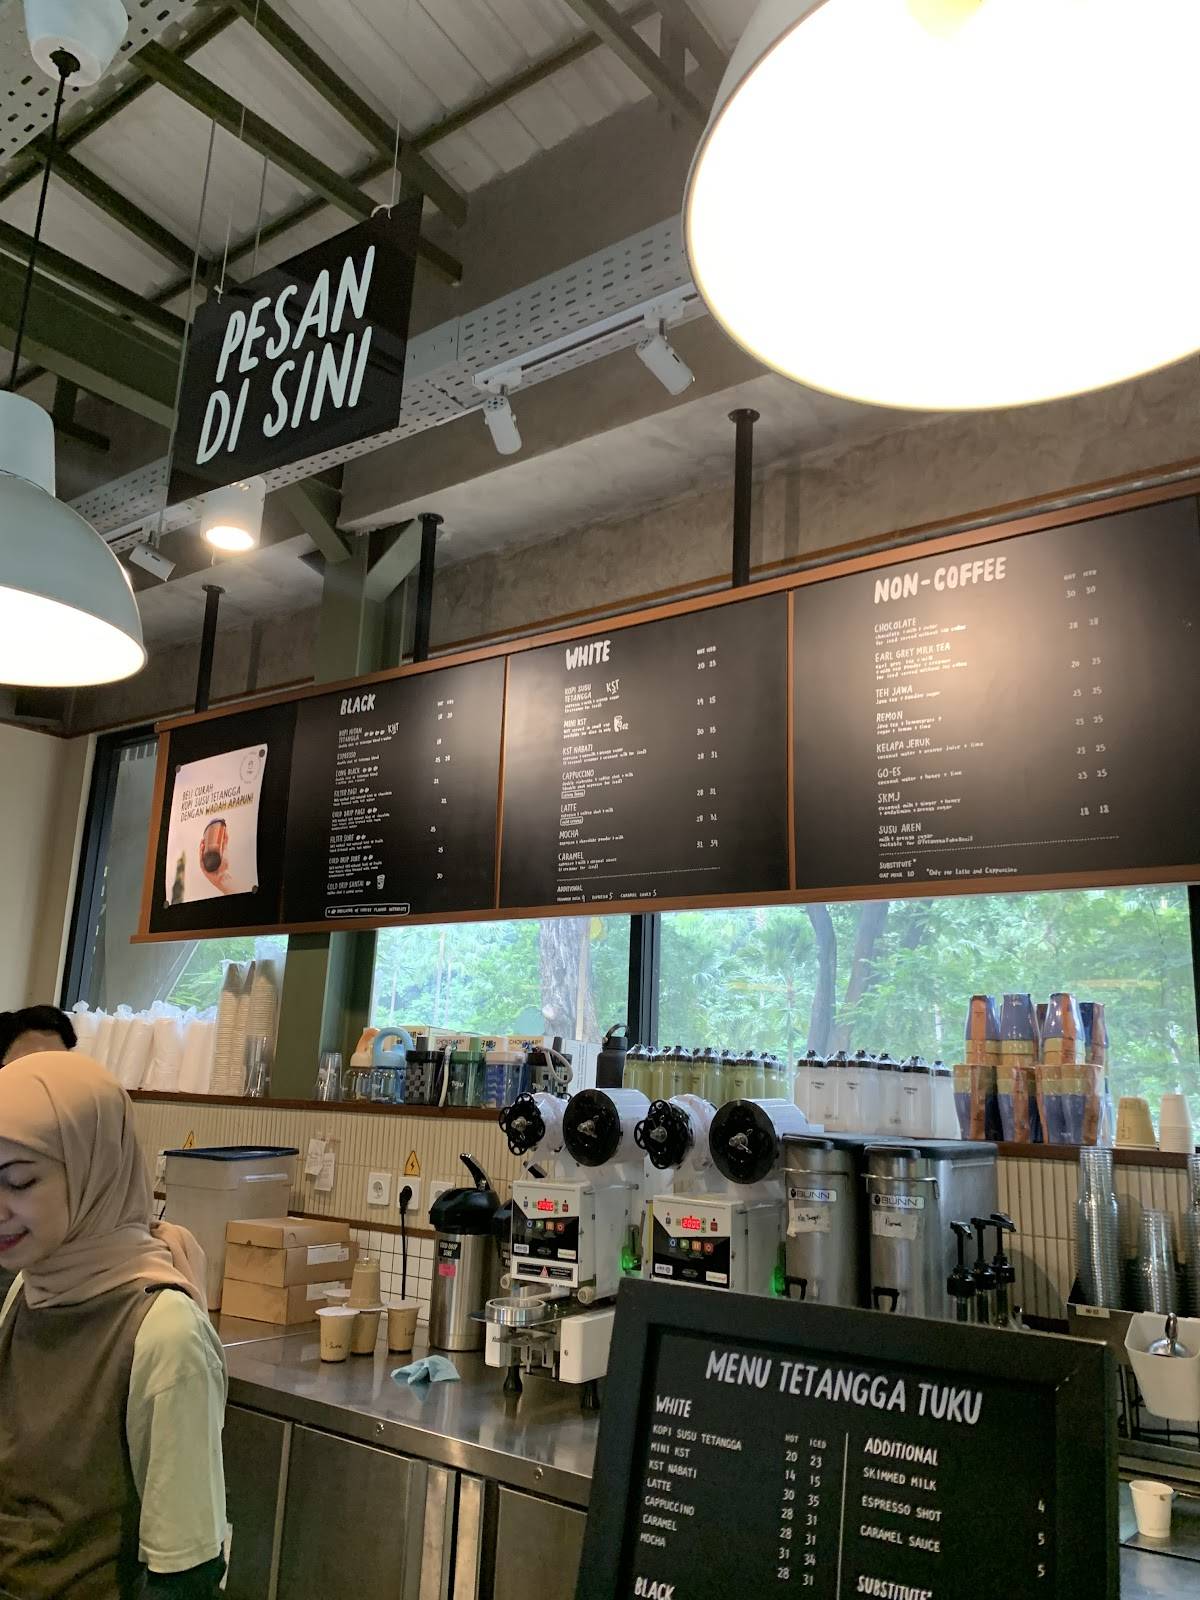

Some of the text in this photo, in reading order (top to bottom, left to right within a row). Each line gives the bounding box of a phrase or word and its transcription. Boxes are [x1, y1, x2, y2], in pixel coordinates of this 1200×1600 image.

[216, 245, 375, 383] PESAN
[196, 326, 372, 465] DI SINI
[874, 557, 1007, 604] NON-COFFEE
[874, 617, 917, 632] CHOCOLATE
[565, 639, 612, 671] WHITE
[875, 651, 893, 663] EARL
[895, 647, 915, 659] GREY
[935, 642, 951, 652] TEA
[875, 684, 913, 698] TEH JAWA
[340, 693, 376, 716] BLACK
[876, 710, 903, 722] REMON
[562, 746, 573, 756] KST
[876, 737, 931, 753] KELAPA JERUK
[562, 769, 595, 781] CAPPUCCINO
[877, 766, 902, 778] GO-ES
[877, 791, 900, 804] SKMJ
[180, 807, 204, 823] DENGAN
[560, 802, 577, 813] LATTE
[559, 828, 579, 839] MOCHA
[878, 822, 922, 835] SUSU AREN
[558, 851, 584, 861] CARAMEL
[797, 1190, 830, 1200] BUNN
[881, 1196, 918, 1206] BUNN
[705, 1350, 983, 1425] MENU TETANGGA TUKU
[655, 1395, 692, 1418] WHITE
[652, 1424, 742, 1451] KOPI SUSU TETANGGA
[784, 1433, 827, 1449] HOT ICED
[650, 1442, 691, 1459] MINI KST
[785, 1450, 822, 1469] 20 23
[864, 1437, 938, 1466] ADDITIONAL
[648, 1459, 697, 1479] KST NABATI
[646, 1478, 672, 1492] LATTE
[784, 1469, 821, 1488] 14 15
[863, 1466, 937, 1492] SKIMMED MILK
[644, 1495, 695, 1516] CAPPUCCINO
[782, 1488, 820, 1507] 30 35
[1037, 1500, 1045, 1513] 4
[781, 1508, 817, 1526] 28 31
[861, 1495, 943, 1523] ESPRESSO SHOT
[642, 1513, 677, 1532] CARAMEL
[639, 1532, 666, 1548] MOCHA
[779, 1527, 816, 1546] 28 31
[860, 1524, 941, 1553] CARAMEL SAUCE
[1037, 1533, 1045, 1546] 5
[778, 1547, 816, 1566] 31 34
[777, 1567, 814, 1586] 28 31
[1037, 1564, 1045, 1578] 5
[633, 1576, 676, 1600] BLACK
